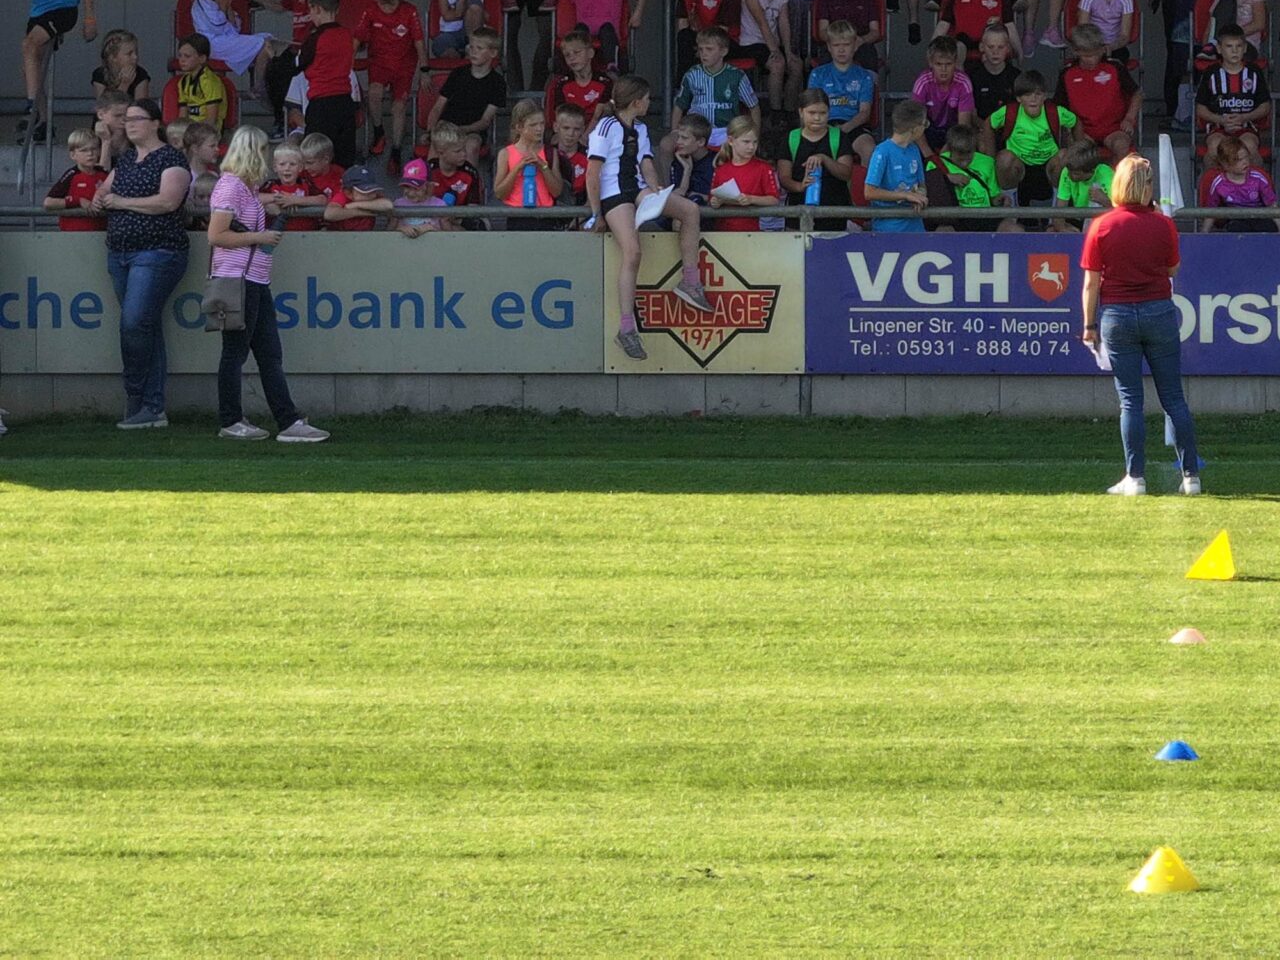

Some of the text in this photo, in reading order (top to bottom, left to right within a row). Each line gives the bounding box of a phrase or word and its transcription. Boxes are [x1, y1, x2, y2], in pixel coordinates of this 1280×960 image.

[698, 250, 724, 287] fL
[845, 250, 1009, 304] VGH
[0, 276, 575, 330] che osbank eG
[681, 328, 724, 350] 1971
[849, 318, 924, 336] Lingener
[928, 318, 957, 333] Str.
[962, 318, 984, 333] 40
[1001, 318, 1070, 337] Meppen
[897, 340, 955, 355] 05931
[976, 340, 1012, 355] 888
[1018, 340, 1041, 355] 40
[1048, 340, 1071, 355] 74
